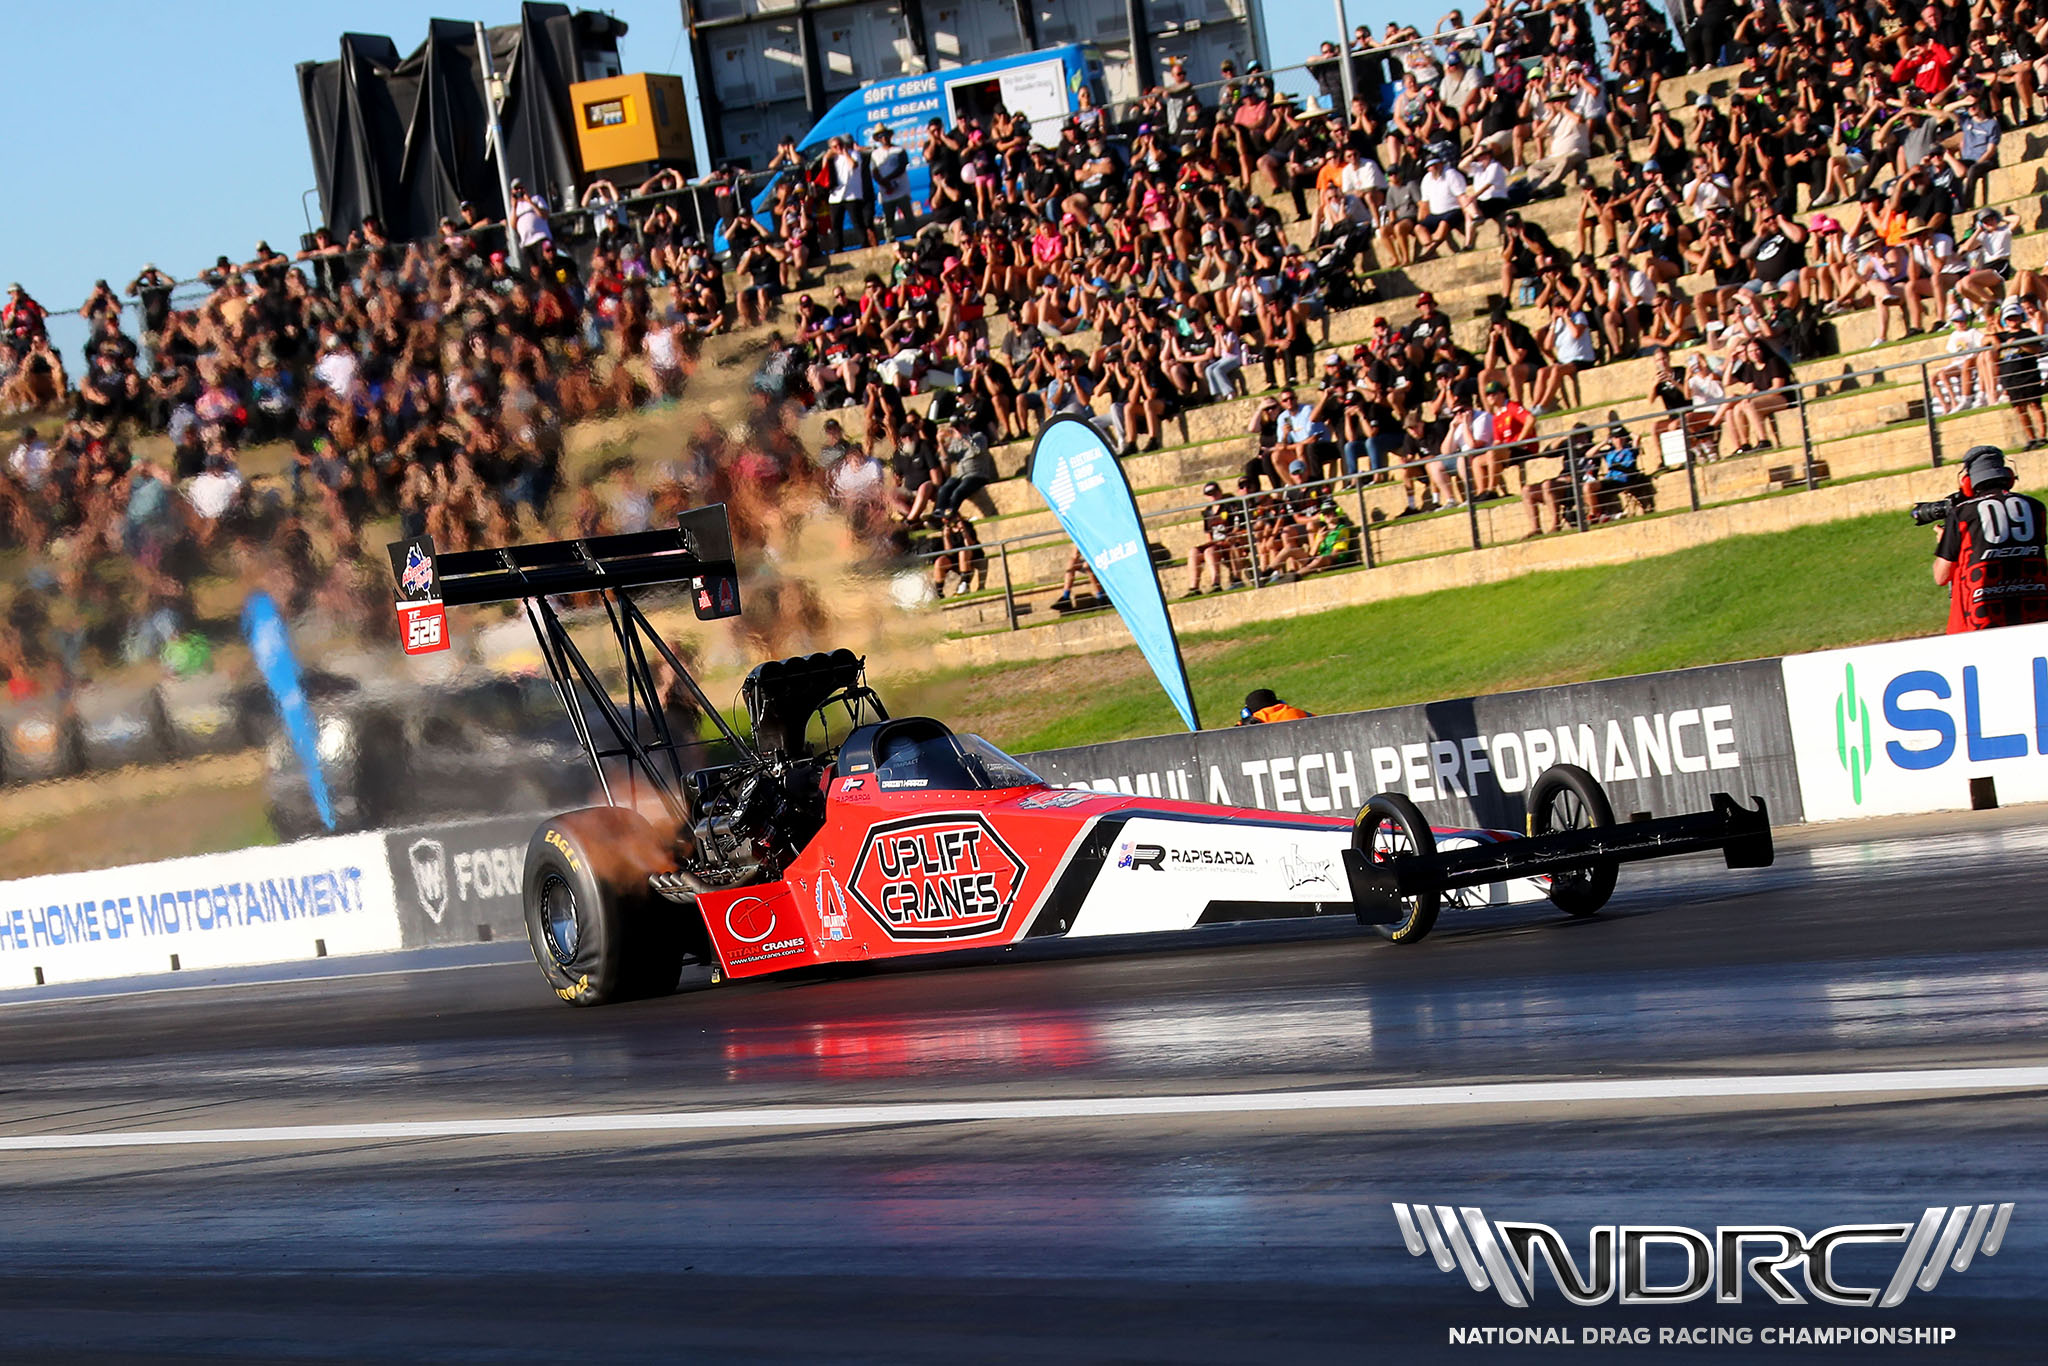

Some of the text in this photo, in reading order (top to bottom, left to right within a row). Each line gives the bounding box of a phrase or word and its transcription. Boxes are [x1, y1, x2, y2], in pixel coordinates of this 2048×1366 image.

[864, 77, 937, 104] SOFT SERVE
[868, 98, 939, 122] ICE CREAM
[1977, 496, 2035, 544] 09
[1980, 546, 2040, 560] MEDIA
[408, 610, 420, 620] TF
[408, 615, 442, 649] 526
[1242, 750, 1361, 812] TECH
[1371, 704, 1741, 803] PERFORMANCE
[544, 830, 582, 873] EAGLE
[876, 828, 981, 880] UPLIFT
[1171, 849, 1255, 866] RAPISARDA
[28, 901, 101, 948] HOME
[102, 898, 135, 939] OF
[137, 867, 364, 936] MOTORTAINMENT
[881, 872, 1001, 925] CRANES
[727, 937, 805, 958] TITAN CRANES
[729, 947, 806, 966] www.titancranes.com.au
